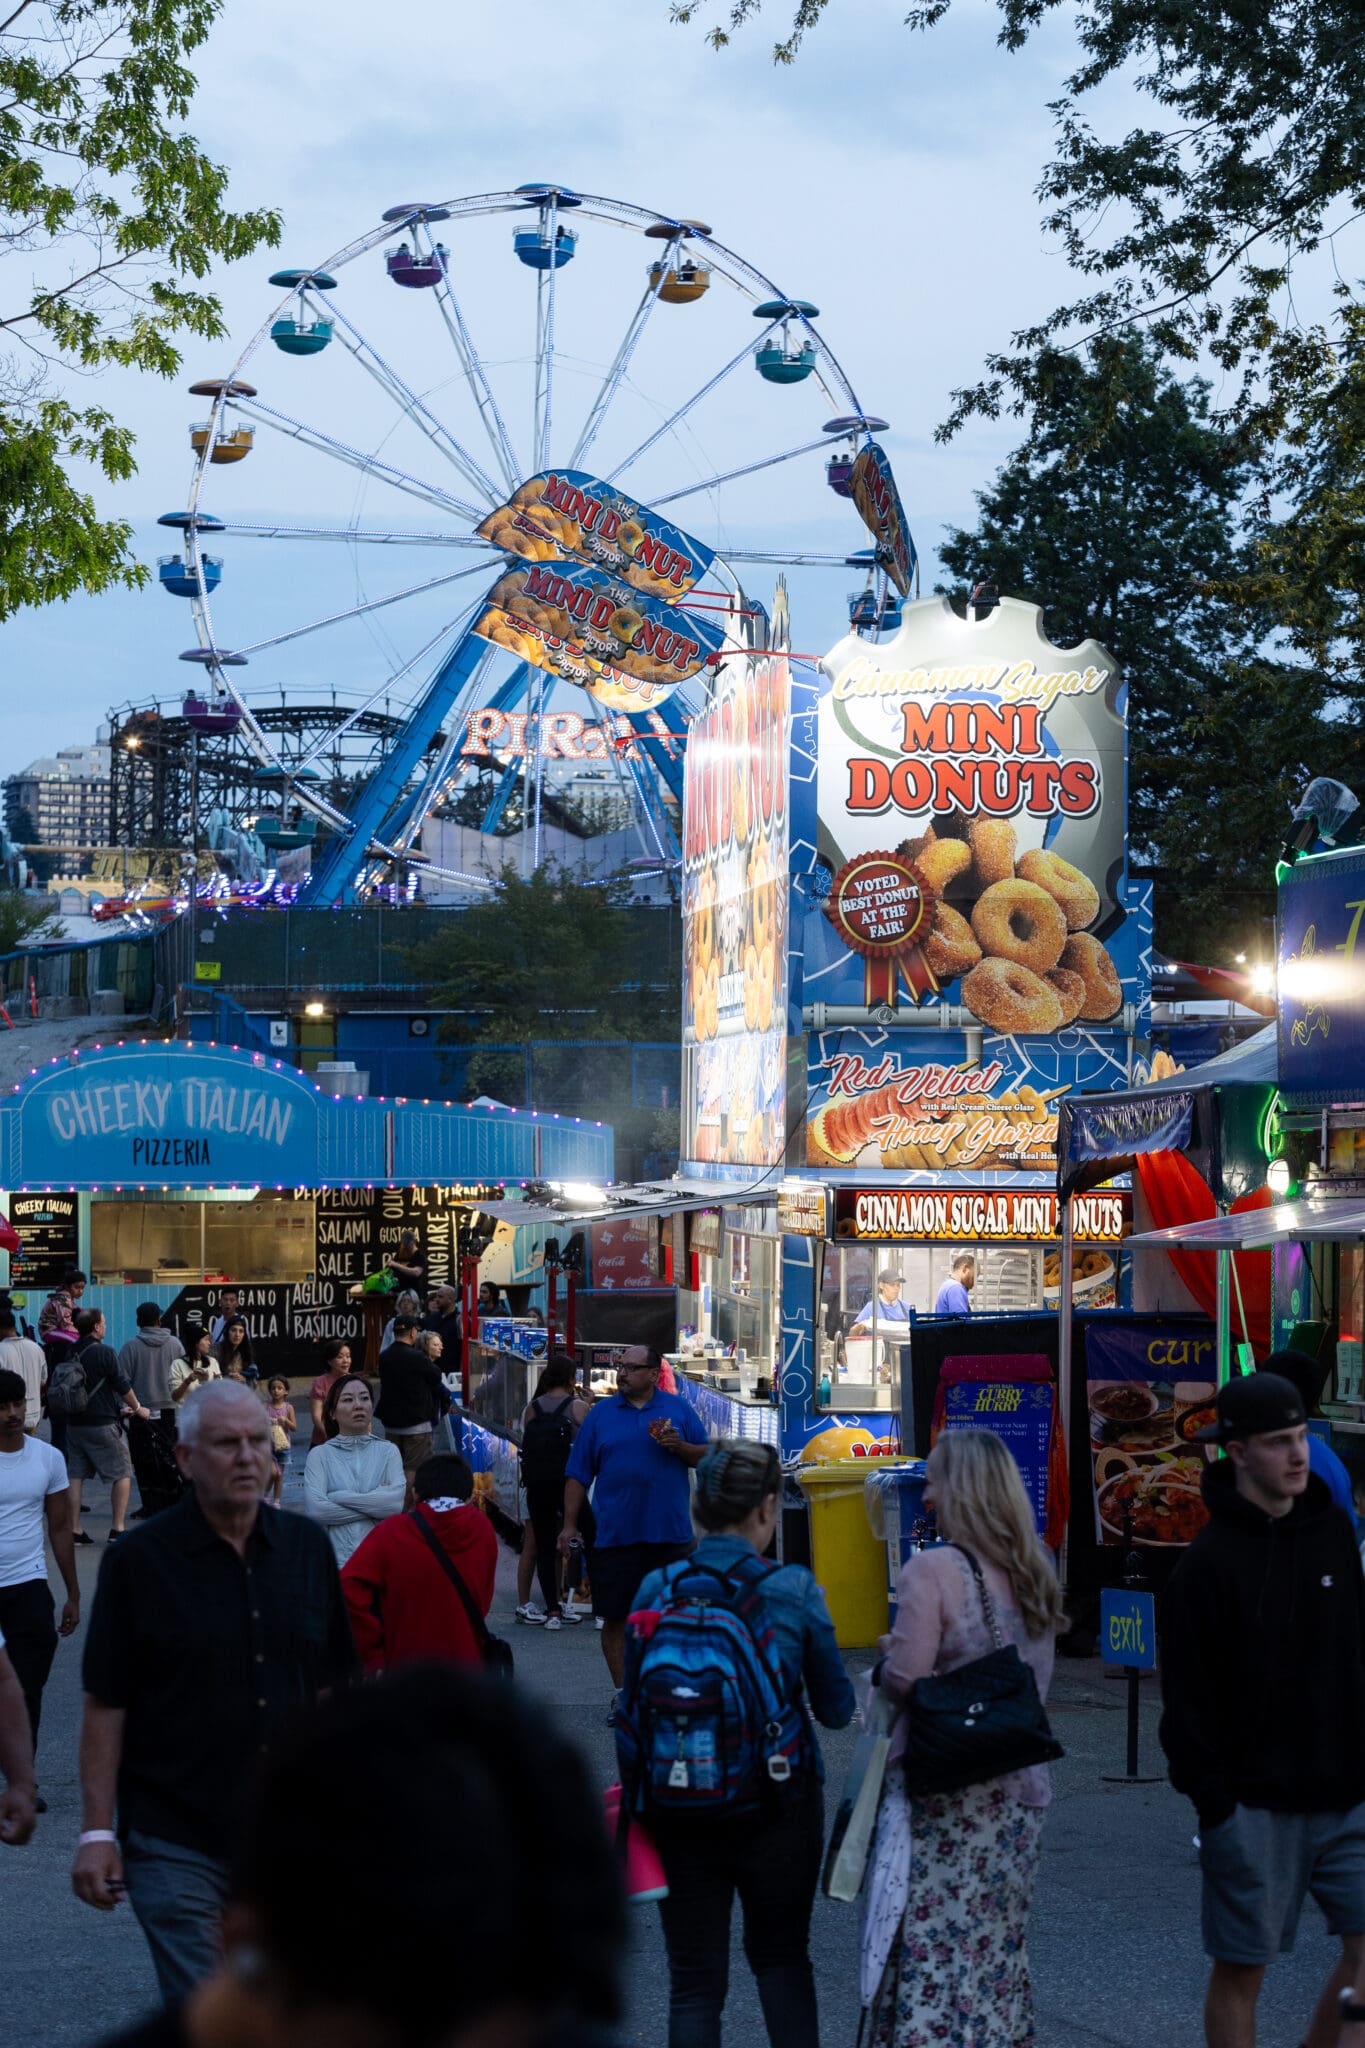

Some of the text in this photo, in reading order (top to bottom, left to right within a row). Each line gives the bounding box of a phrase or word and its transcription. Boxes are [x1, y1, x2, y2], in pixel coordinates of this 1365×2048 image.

[616, 500, 634, 518] THE
[541, 474, 602, 530] MINI
[602, 507, 691, 587] DONUT
[588, 536, 625, 564] FACTORY
[609, 587, 629, 602] THE
[523, 566, 594, 619] MINI
[590, 596, 700, 671] DONUT
[582, 626, 619, 653] FACTORY
[832, 657, 1110, 711] Cinnamon Sugar
[900, 702, 1043, 757] MINI
[845, 758, 1099, 814] DONUTS
[854, 874, 900, 896] VOTED
[841, 885, 919, 913] BEST DONUT
[861, 904, 908, 925] AT THE
[868, 920, 904, 939] FAIR!
[822, 1054, 898, 1097] Red
[889, 1060, 1003, 1103] Velvet
[51, 1080, 292, 1147] CHEEKY ITALIAN
[921, 1103, 1035, 1112] with Real Cream Cheese Glaze
[132, 1137, 210, 1166] PIZZERIA
[871, 1114, 965, 1154] Honey
[957, 1115, 1058, 1164] Glazed
[998, 1151, 1057, 1160] with Real Hon
[14, 1200, 45, 1216] CHEEKY
[411, 1186, 428, 1207] AL
[856, 1194, 1123, 1237] CINNAMON SUGAR MINI NUTS
[318, 1220, 420, 1244] SALAMI GUSTA
[318, 1253, 354, 1277] SALE
[363, 1253, 373, 1276] E
[207, 1289, 277, 1306] OGANO
[293, 1281, 335, 1306] AGLIO
[294, 1314, 358, 1340] BASILICO
[974, 1399, 1021, 1412] HURRY
[979, 1388, 1025, 1400] CURRY
[1109, 1605, 1145, 1654] exit
